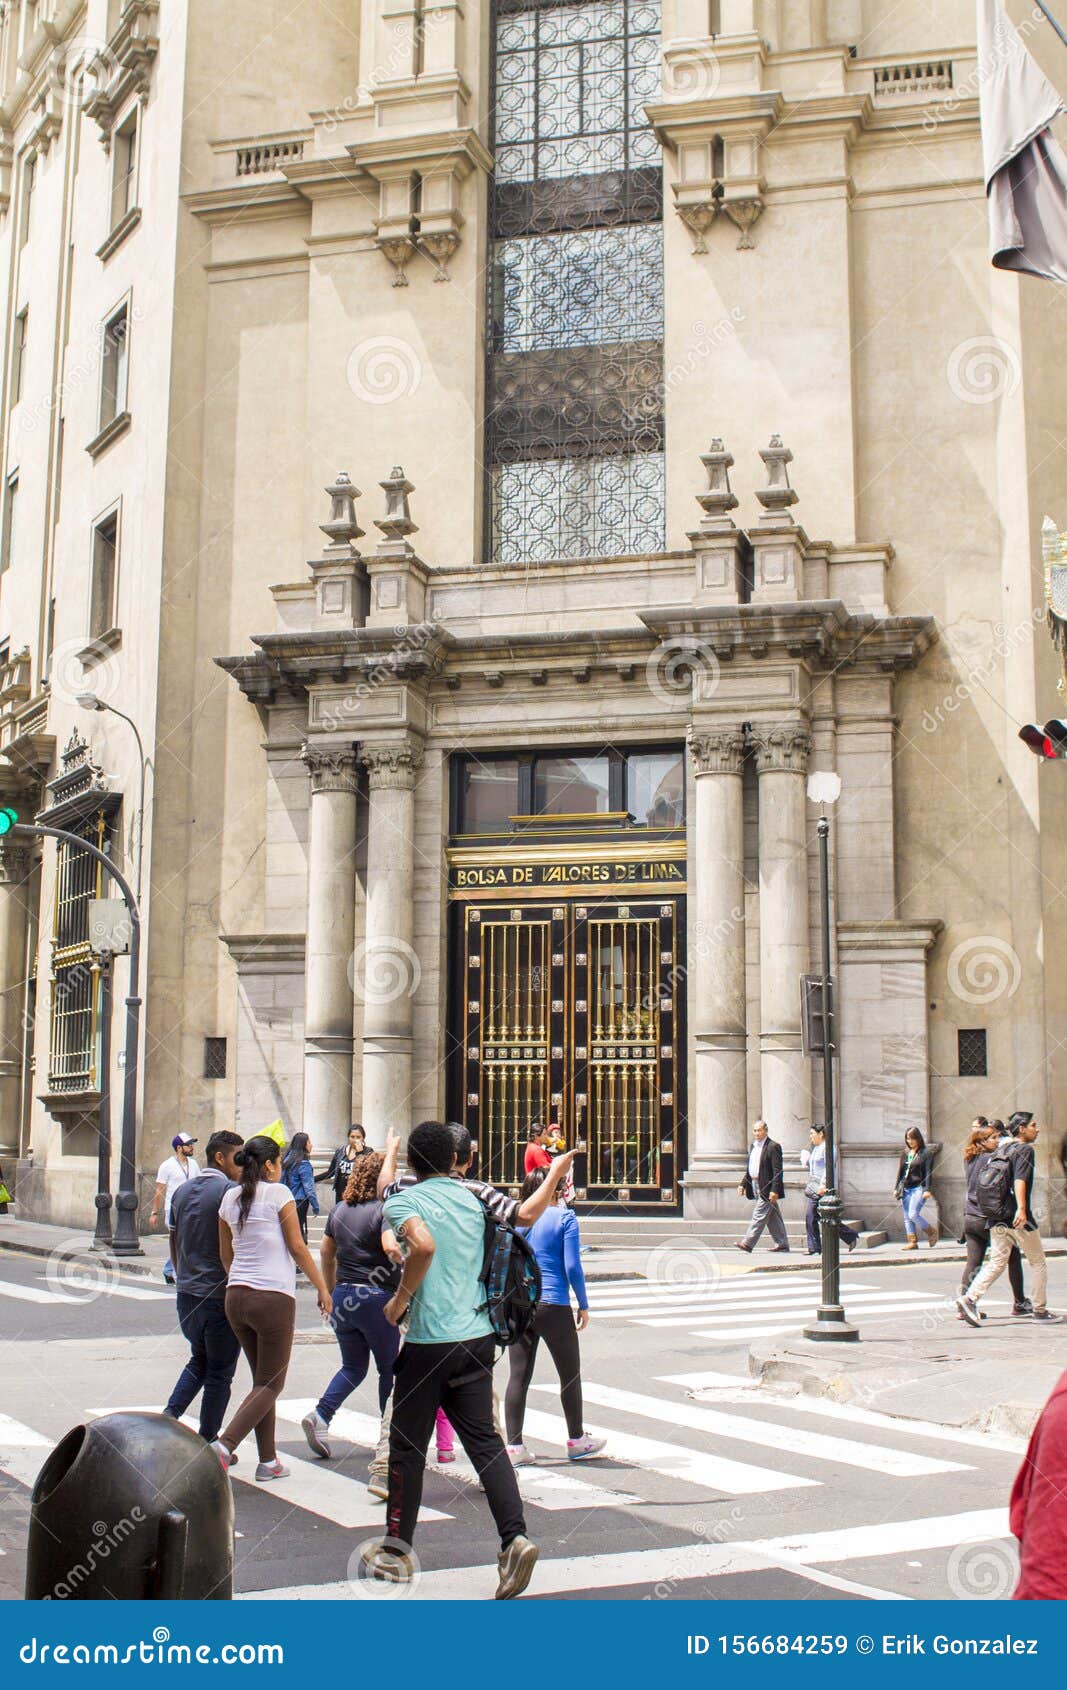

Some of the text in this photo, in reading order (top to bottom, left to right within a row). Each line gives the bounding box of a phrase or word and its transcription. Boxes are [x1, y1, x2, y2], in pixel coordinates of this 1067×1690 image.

[457, 863, 684, 886] BOLSA DE VALORES DE LIMA
